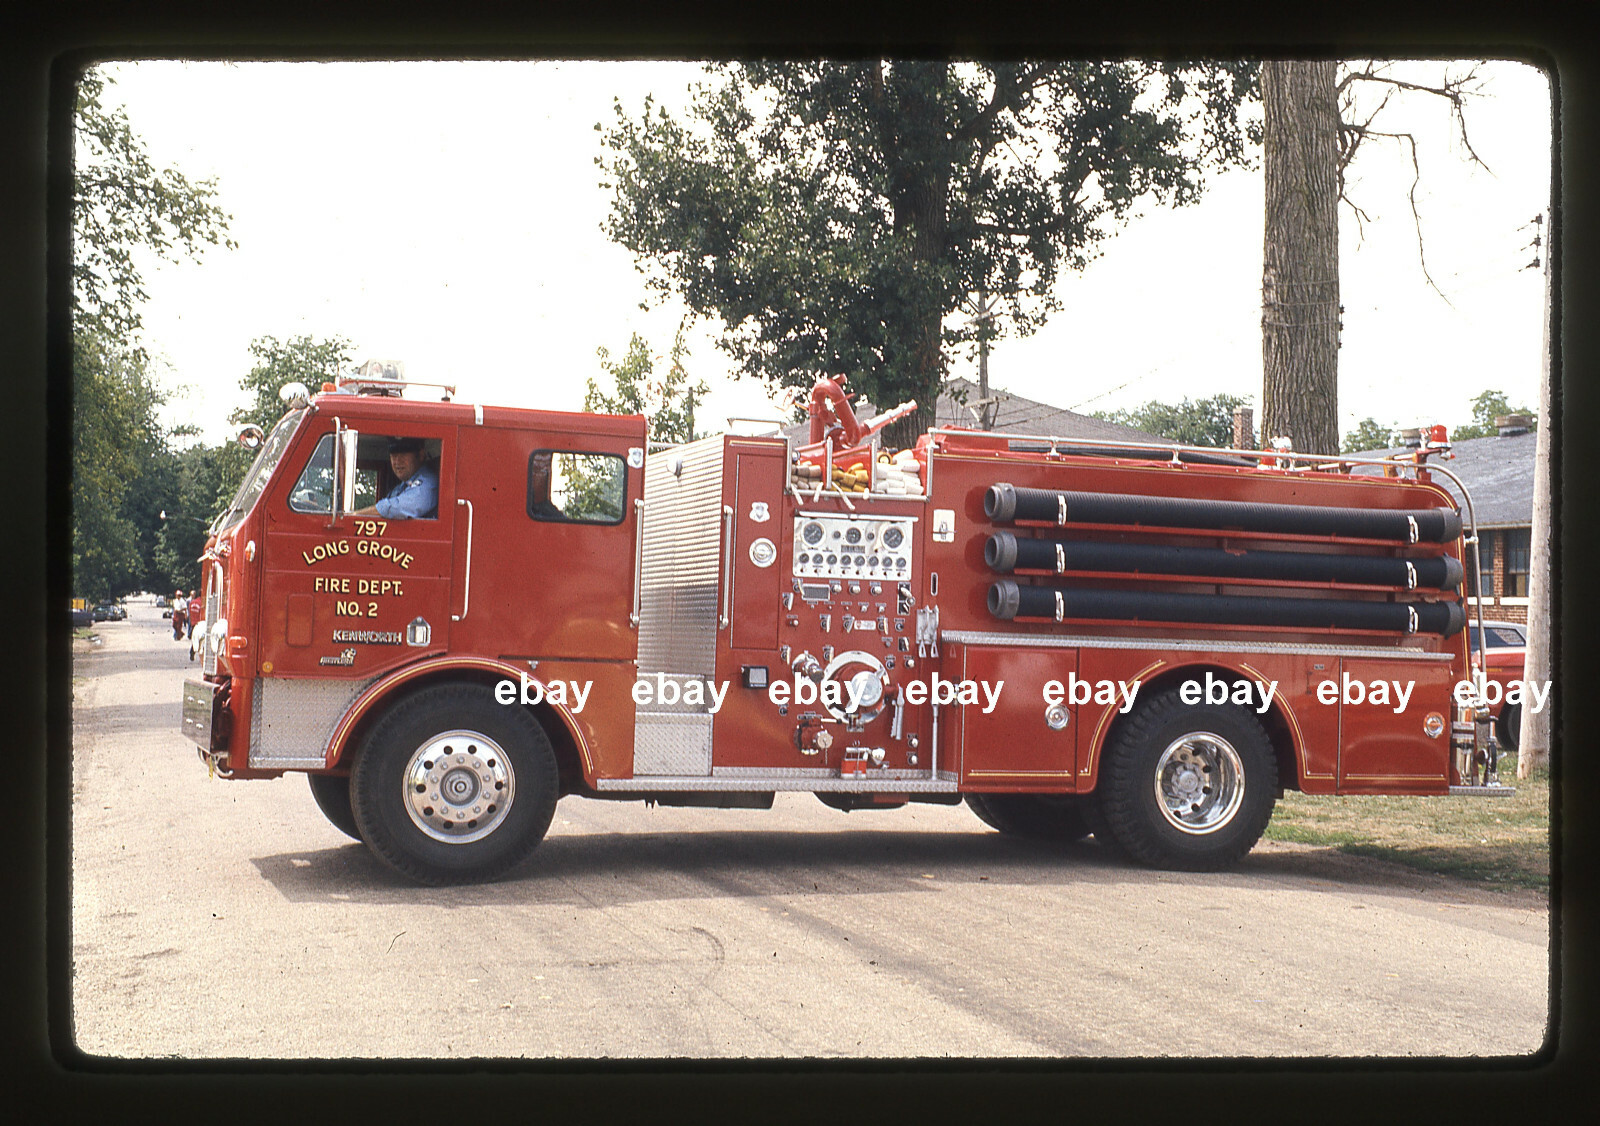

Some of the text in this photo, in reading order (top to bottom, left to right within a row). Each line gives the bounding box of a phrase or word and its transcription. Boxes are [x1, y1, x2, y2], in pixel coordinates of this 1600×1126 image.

[354, 520, 388, 537] 797
[302, 539, 415, 570] LONG GROVE
[314, 577, 404, 596] FIRE DEPT.
[336, 601, 379, 618] NO. 2
[332, 629, 403, 644] KENWORTH
